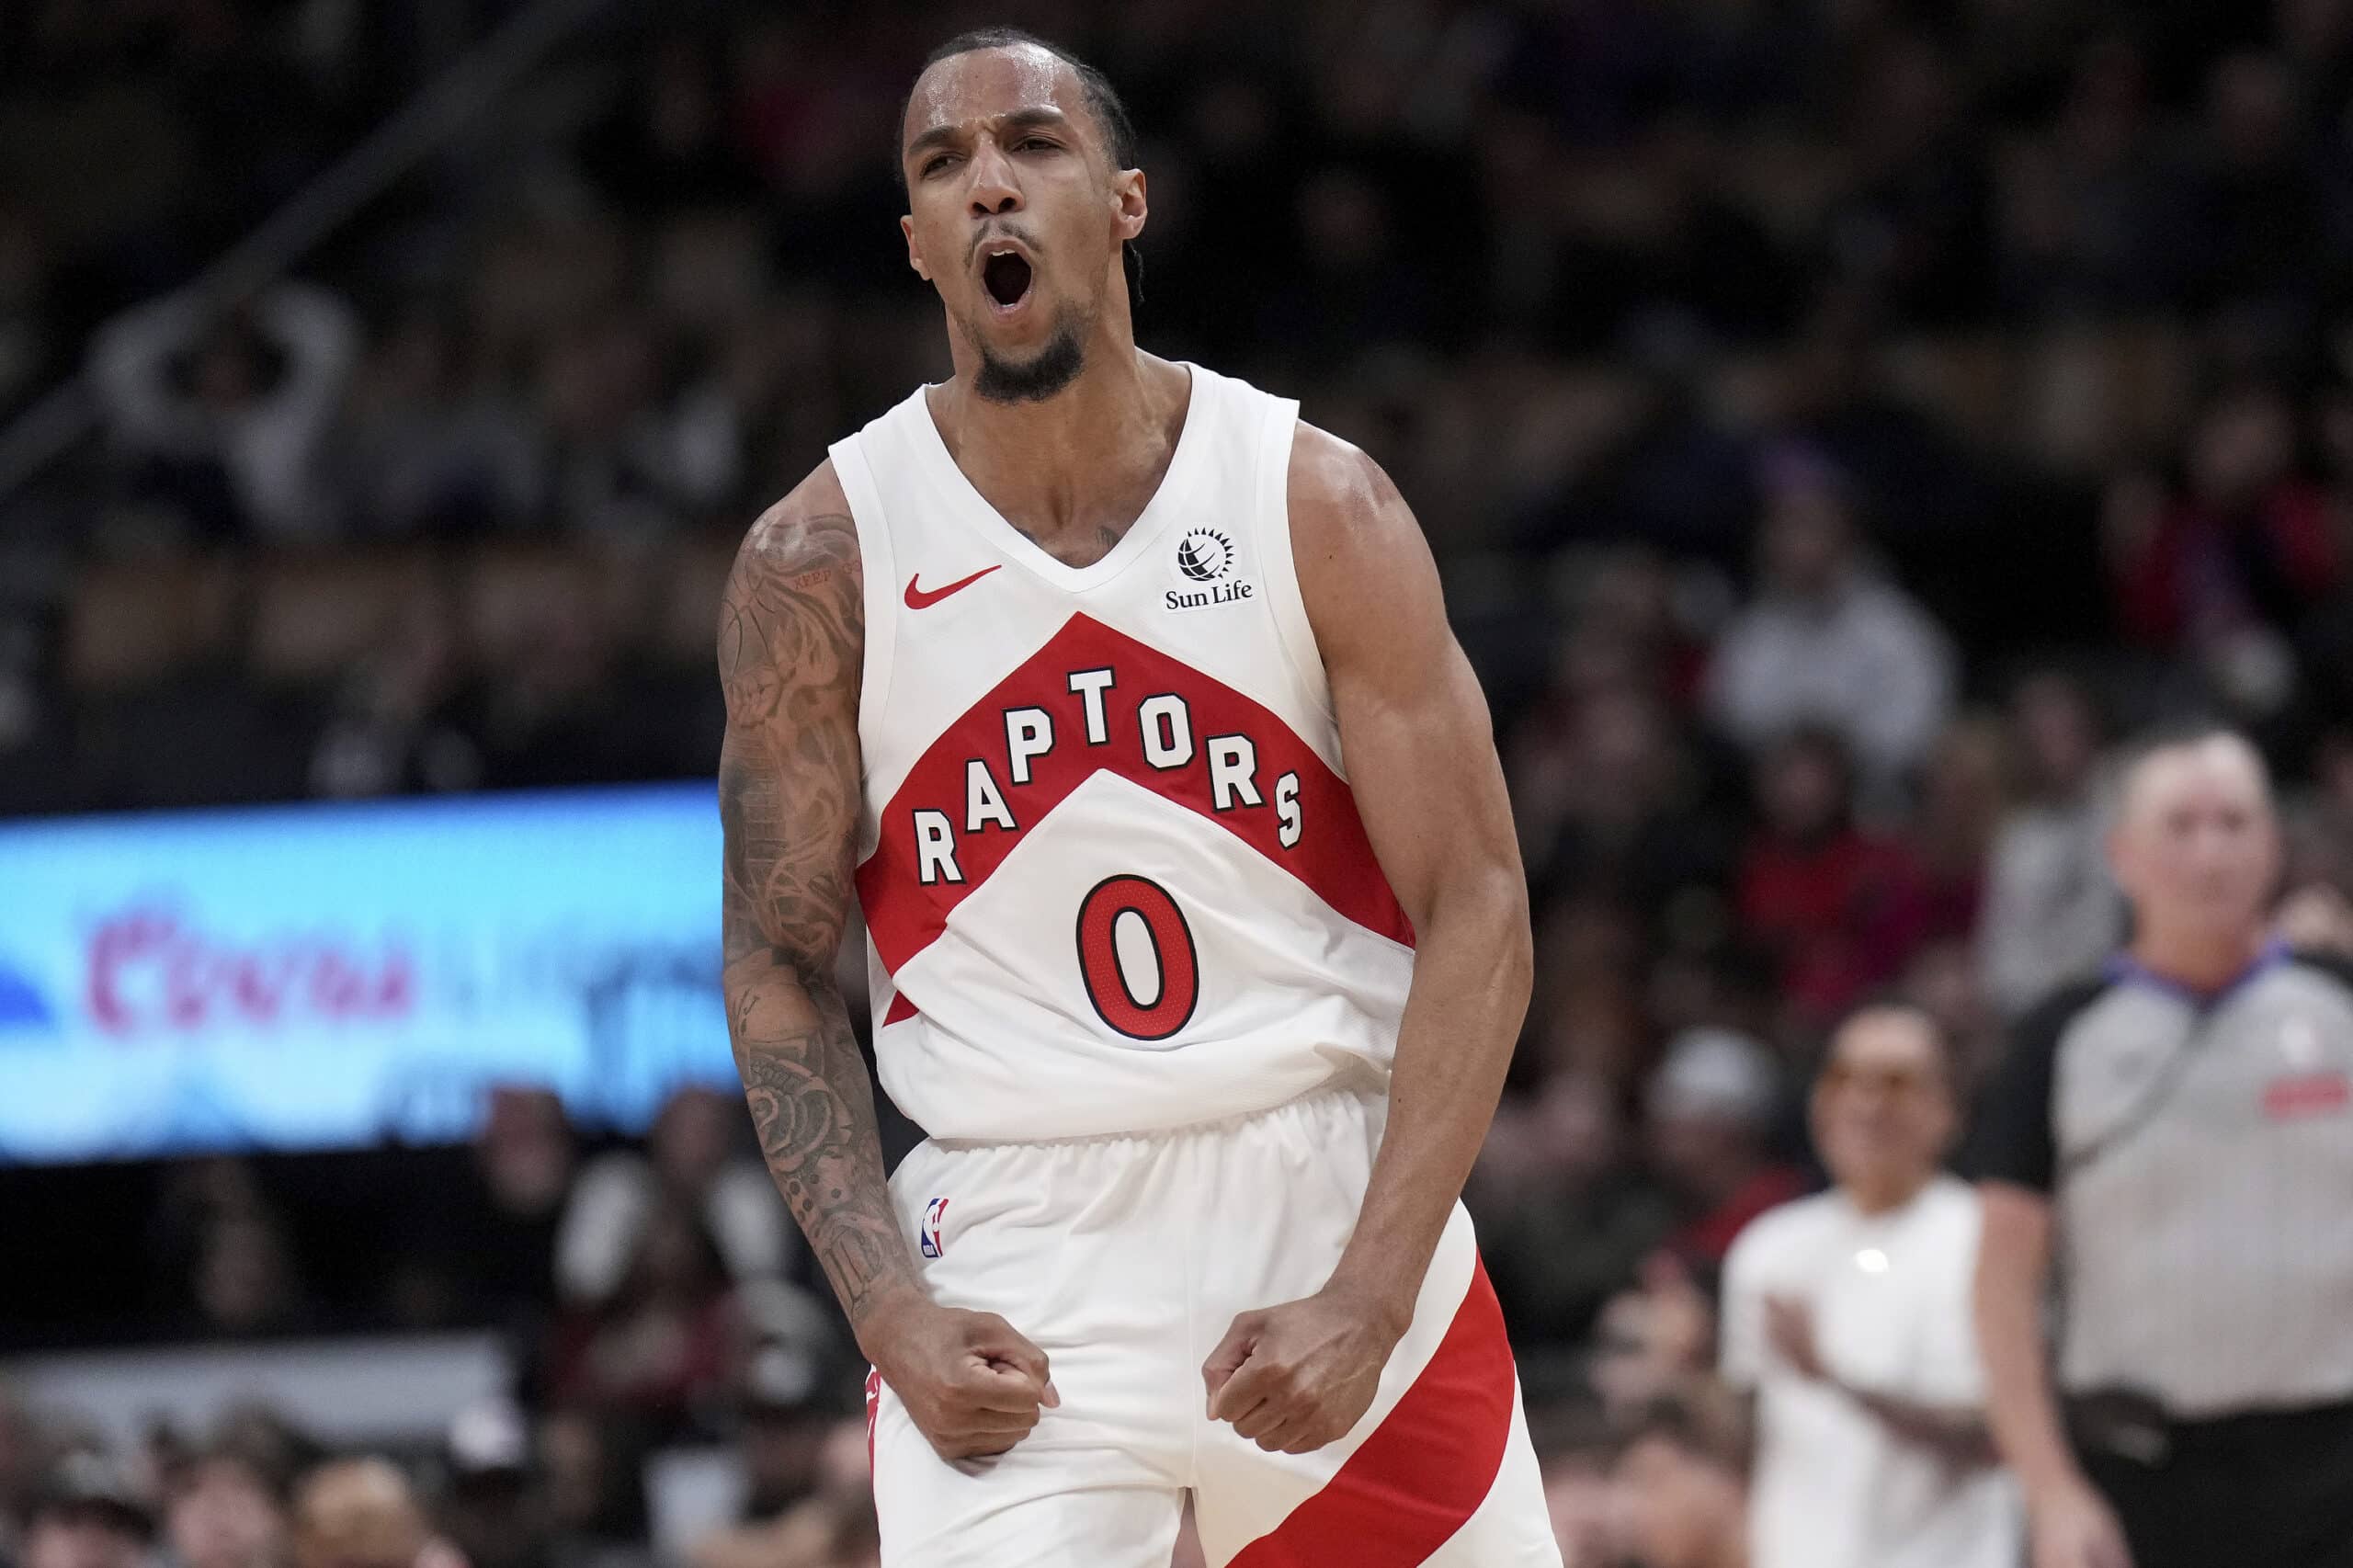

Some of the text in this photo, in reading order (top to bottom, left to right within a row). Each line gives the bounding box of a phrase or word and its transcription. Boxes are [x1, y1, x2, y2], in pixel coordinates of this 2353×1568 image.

[1165, 579, 1253, 609] Sun Life
[912, 666, 1302, 884] RAPTORS
[1076, 874, 1199, 1040] 0
